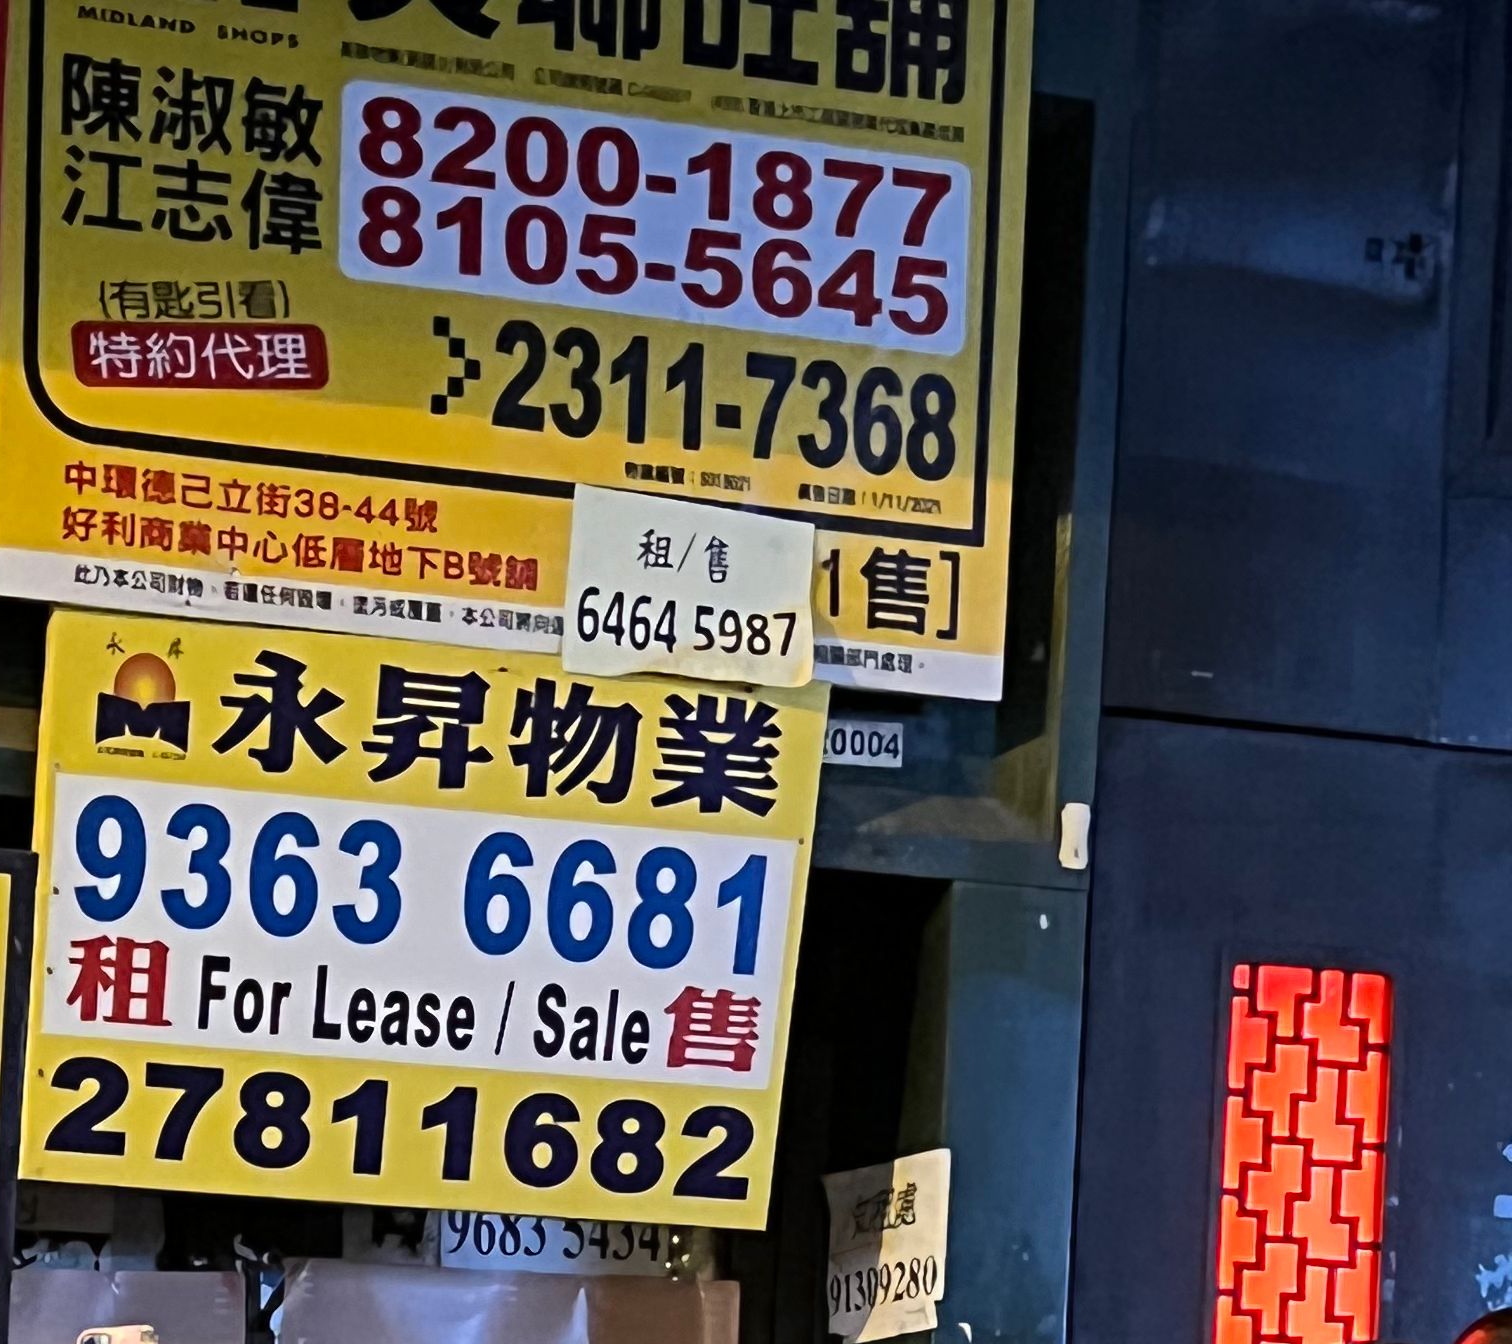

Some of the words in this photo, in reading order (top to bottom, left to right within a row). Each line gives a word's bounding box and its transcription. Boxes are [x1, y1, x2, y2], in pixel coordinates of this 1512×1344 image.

[77, 5, 196, 34] MIDLAND
[217, 25, 299, 48] SHOPS
[61, 53, 324, 167] 陳淑敏
[61, 145, 323, 255] 江志偉
[358, 96, 953, 248] 8200-1877
[358, 185, 948, 336] 8105-5645
[88, 332, 313, 380] 特約代理
[491, 320, 957, 481] 2311-7368
[63, 460, 438, 534] 中環德己立街38-44號
[637, 528, 730, 584] 租/售
[577, 586, 678, 654] 6464
[693, 604, 797, 657] 5987
[211, 650, 784, 818] 永昇物業
[73, 794, 403, 945] 9363
[464, 832, 768, 976] 6681
[66, 935, 172, 1027] 租
[197, 954, 292, 1034] For
[313, 964, 476, 1052] Lease
[533, 983, 650, 1065] Sale
[663, 986, 763, 1073] 售
[44, 1056, 756, 1201] 27811682
[830, 1255, 938, 1316] 91309280
